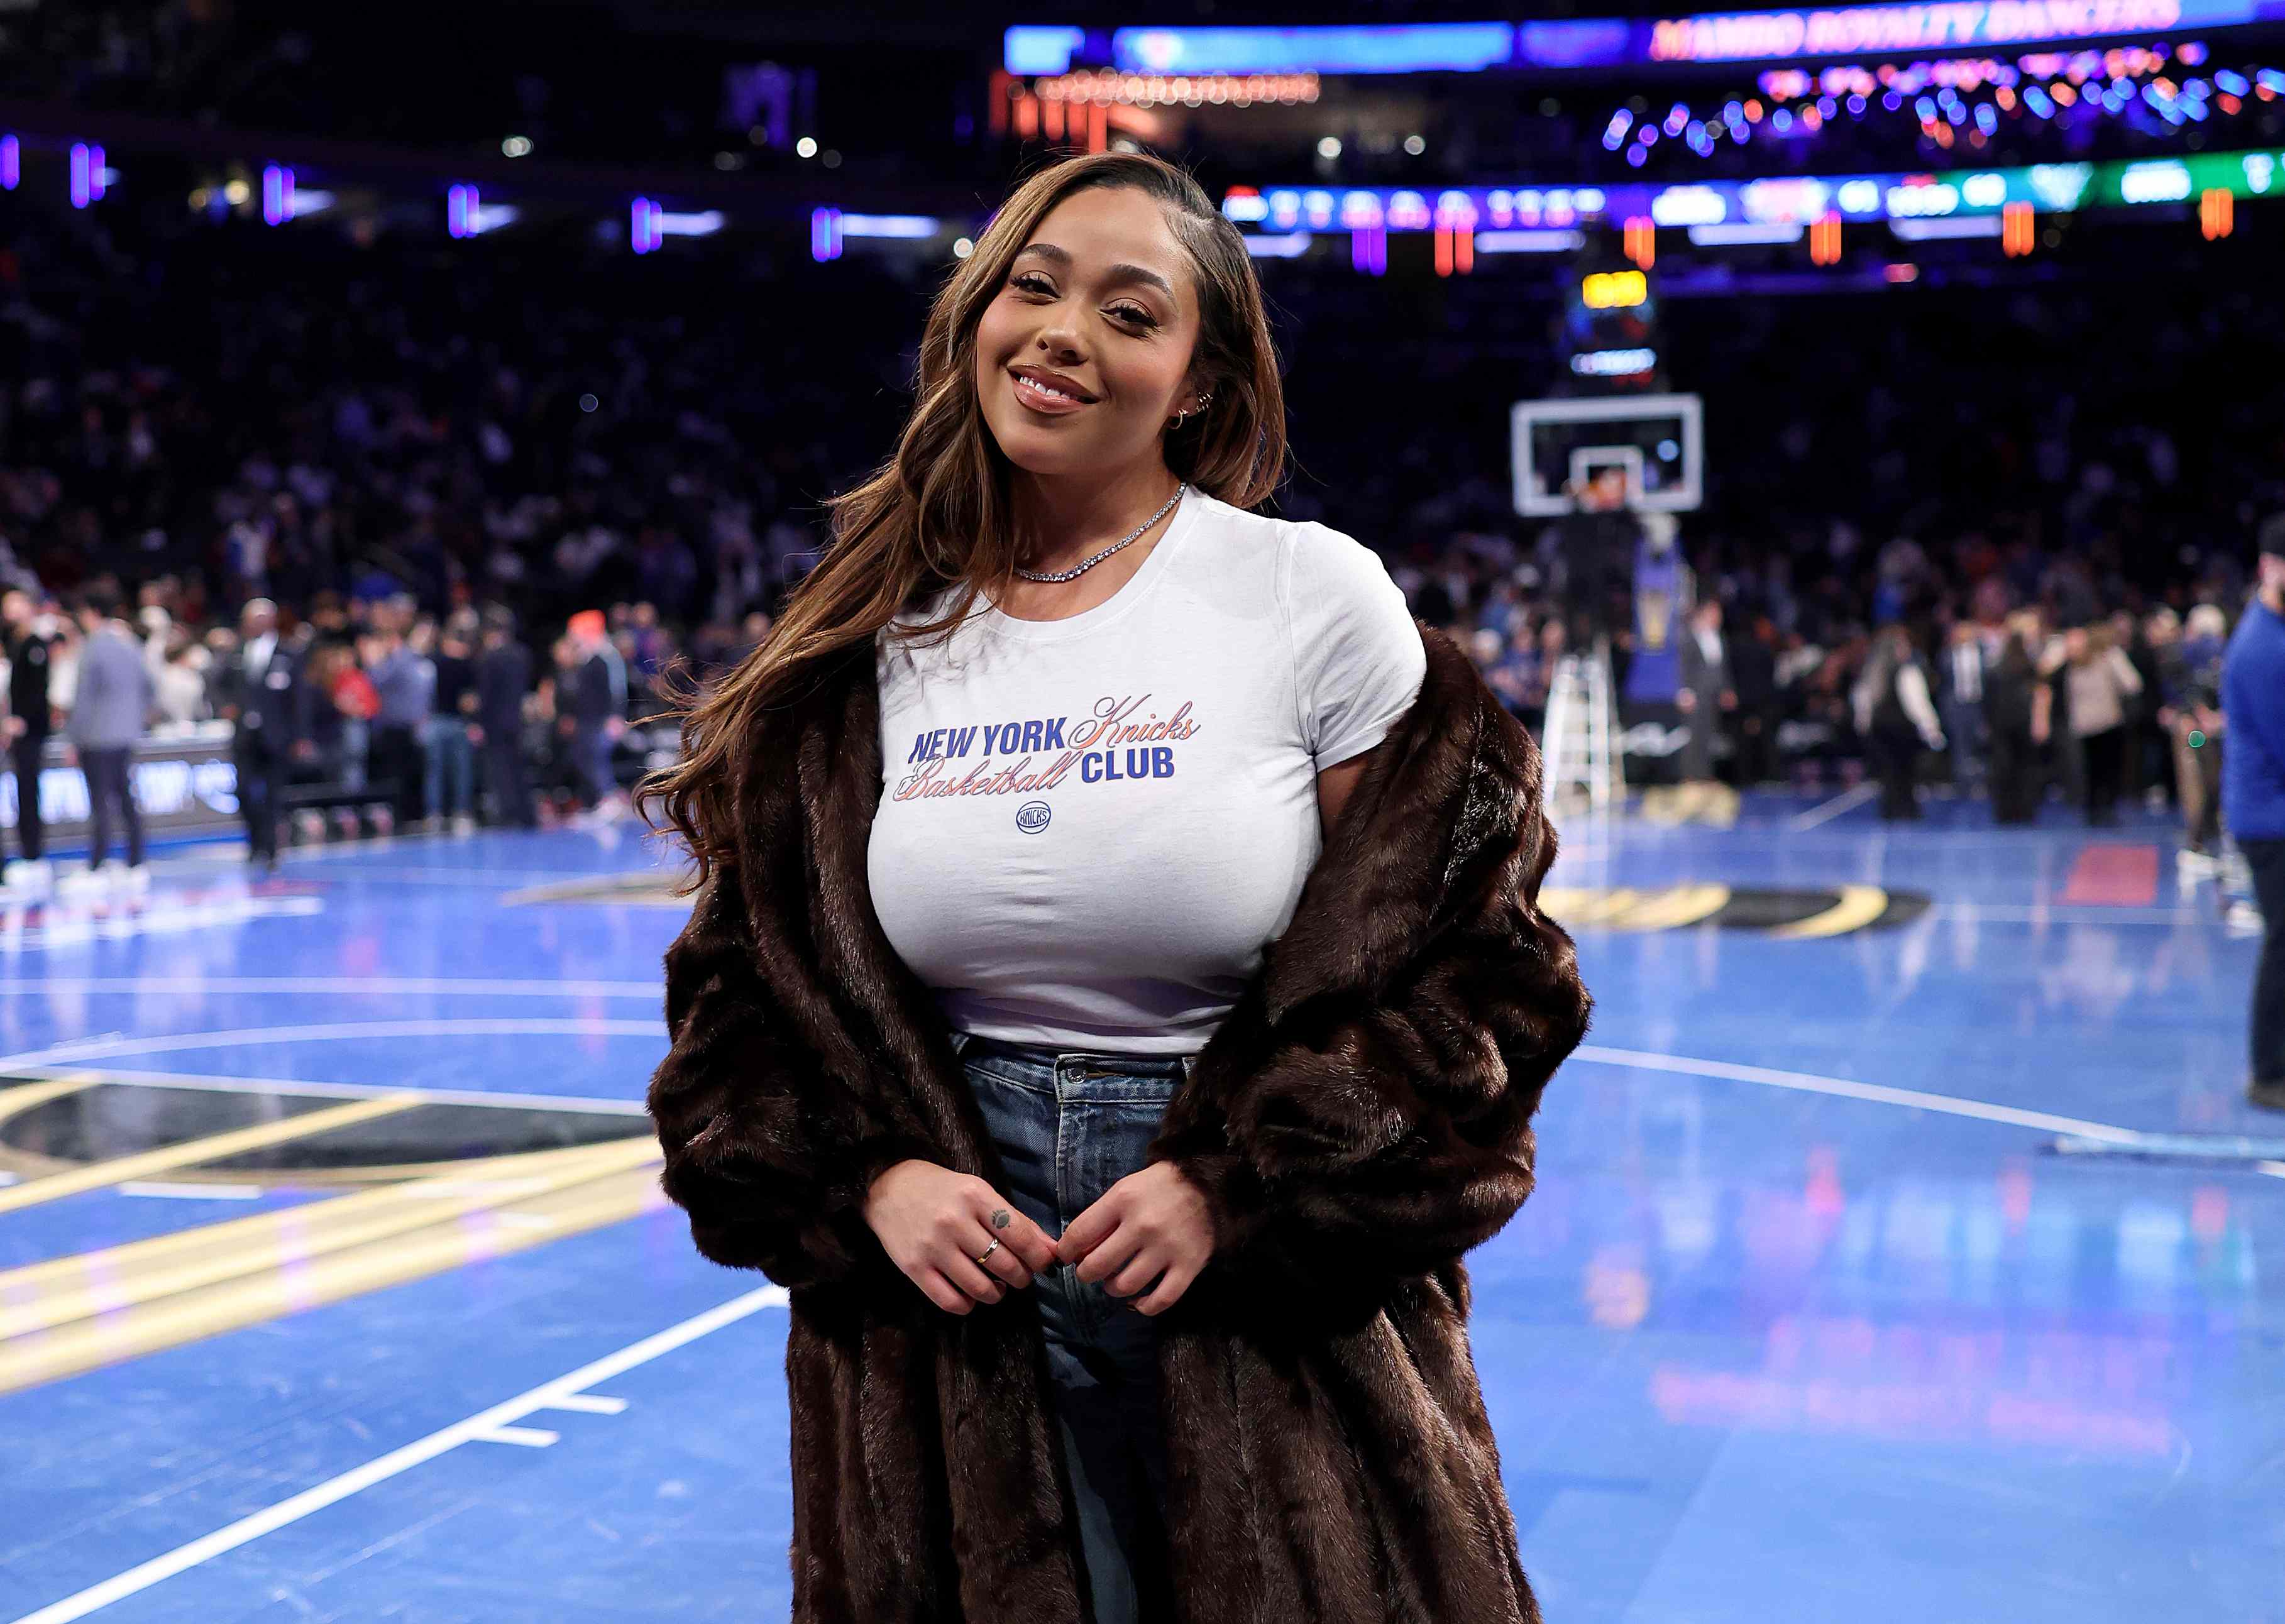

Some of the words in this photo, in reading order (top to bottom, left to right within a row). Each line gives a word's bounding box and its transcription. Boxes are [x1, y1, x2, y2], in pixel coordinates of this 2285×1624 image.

[908, 726, 977, 764] NEW
[983, 716, 1067, 756] YORK
[1067, 693, 1201, 750] Knicks
[893, 750, 1084, 801] Basketball
[1081, 747, 1175, 784] CLUB
[1020, 809, 1047, 825] KNICKS
